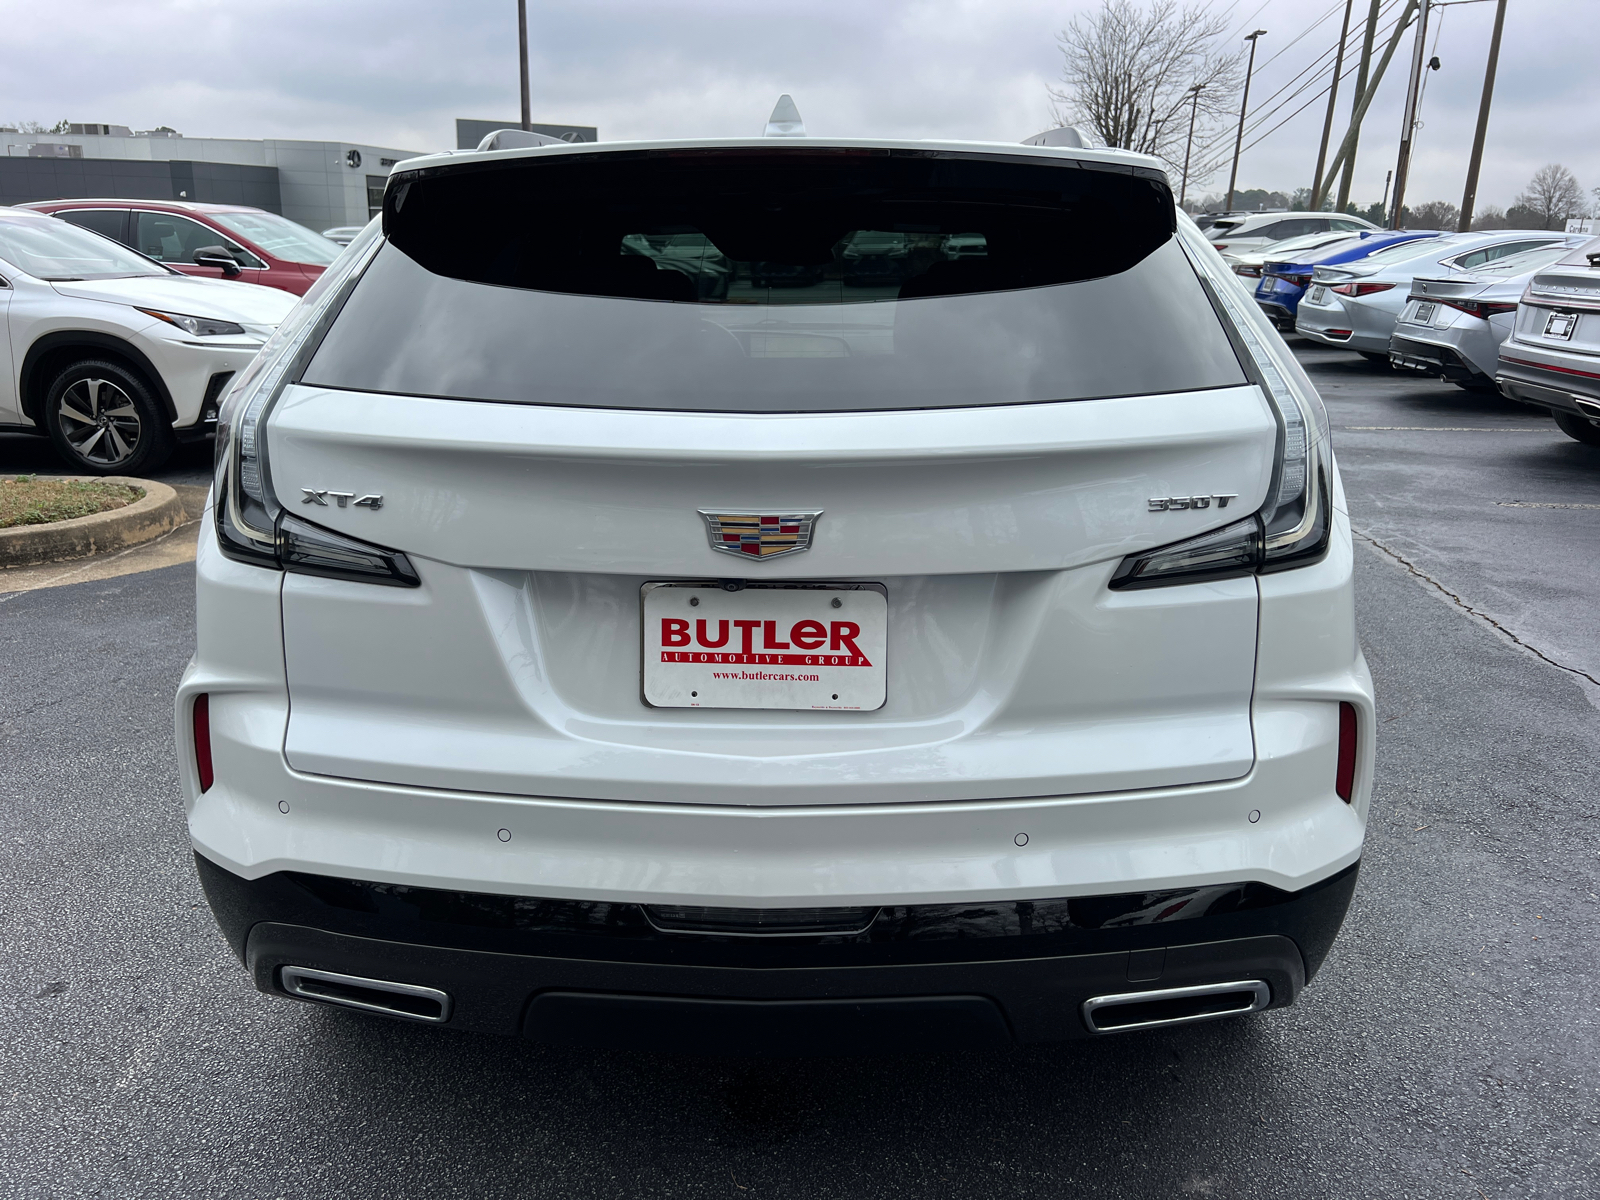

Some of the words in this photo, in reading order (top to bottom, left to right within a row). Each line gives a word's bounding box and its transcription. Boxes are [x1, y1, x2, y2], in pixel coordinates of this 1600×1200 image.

[300, 487, 383, 510] XT4
[1147, 494, 1239, 512] 350T
[662, 652, 784, 664] AUTOMOTIVE
[805, 656, 865, 666] GROUP
[713, 671, 820, 682] www.butlercars.com
